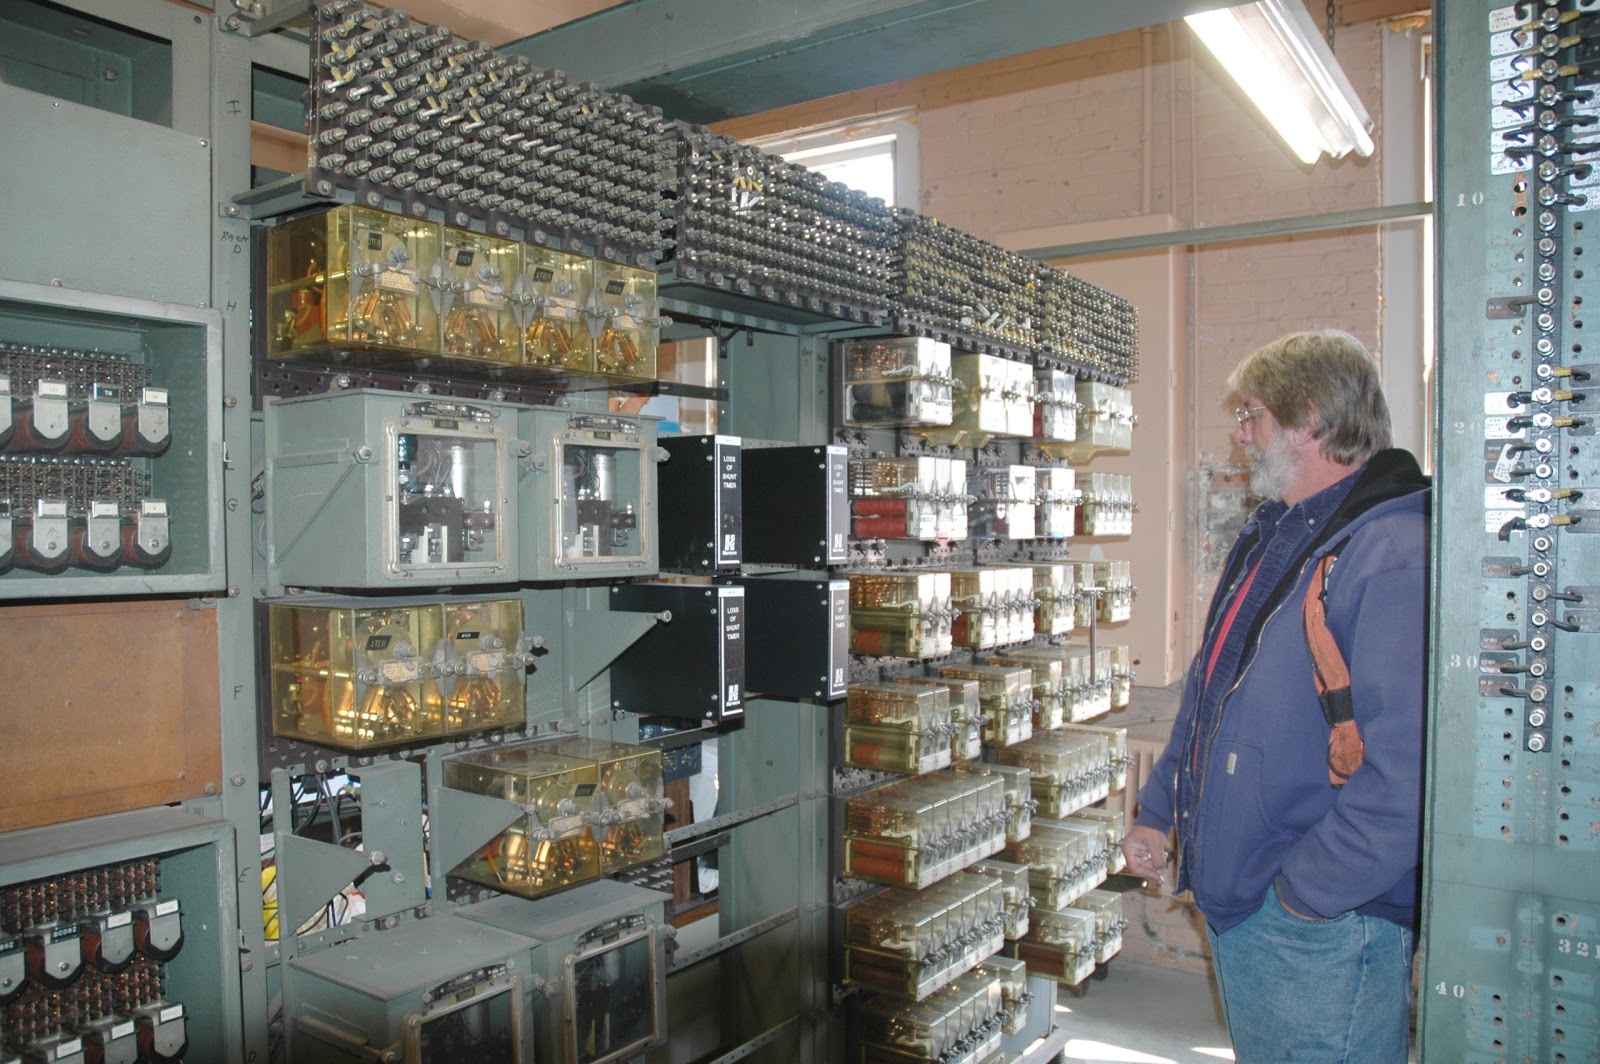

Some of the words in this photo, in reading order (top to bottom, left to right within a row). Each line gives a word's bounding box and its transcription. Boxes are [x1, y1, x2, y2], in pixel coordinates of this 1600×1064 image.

[1455, 191, 1485, 207] 10
[233, 245, 242, 254] D
[226, 301, 237, 312] H
[726, 624, 740, 632] SHUNT
[1450, 654, 1478, 670] 30
[233, 685, 243, 700] F
[1434, 981, 1466, 998] 40
